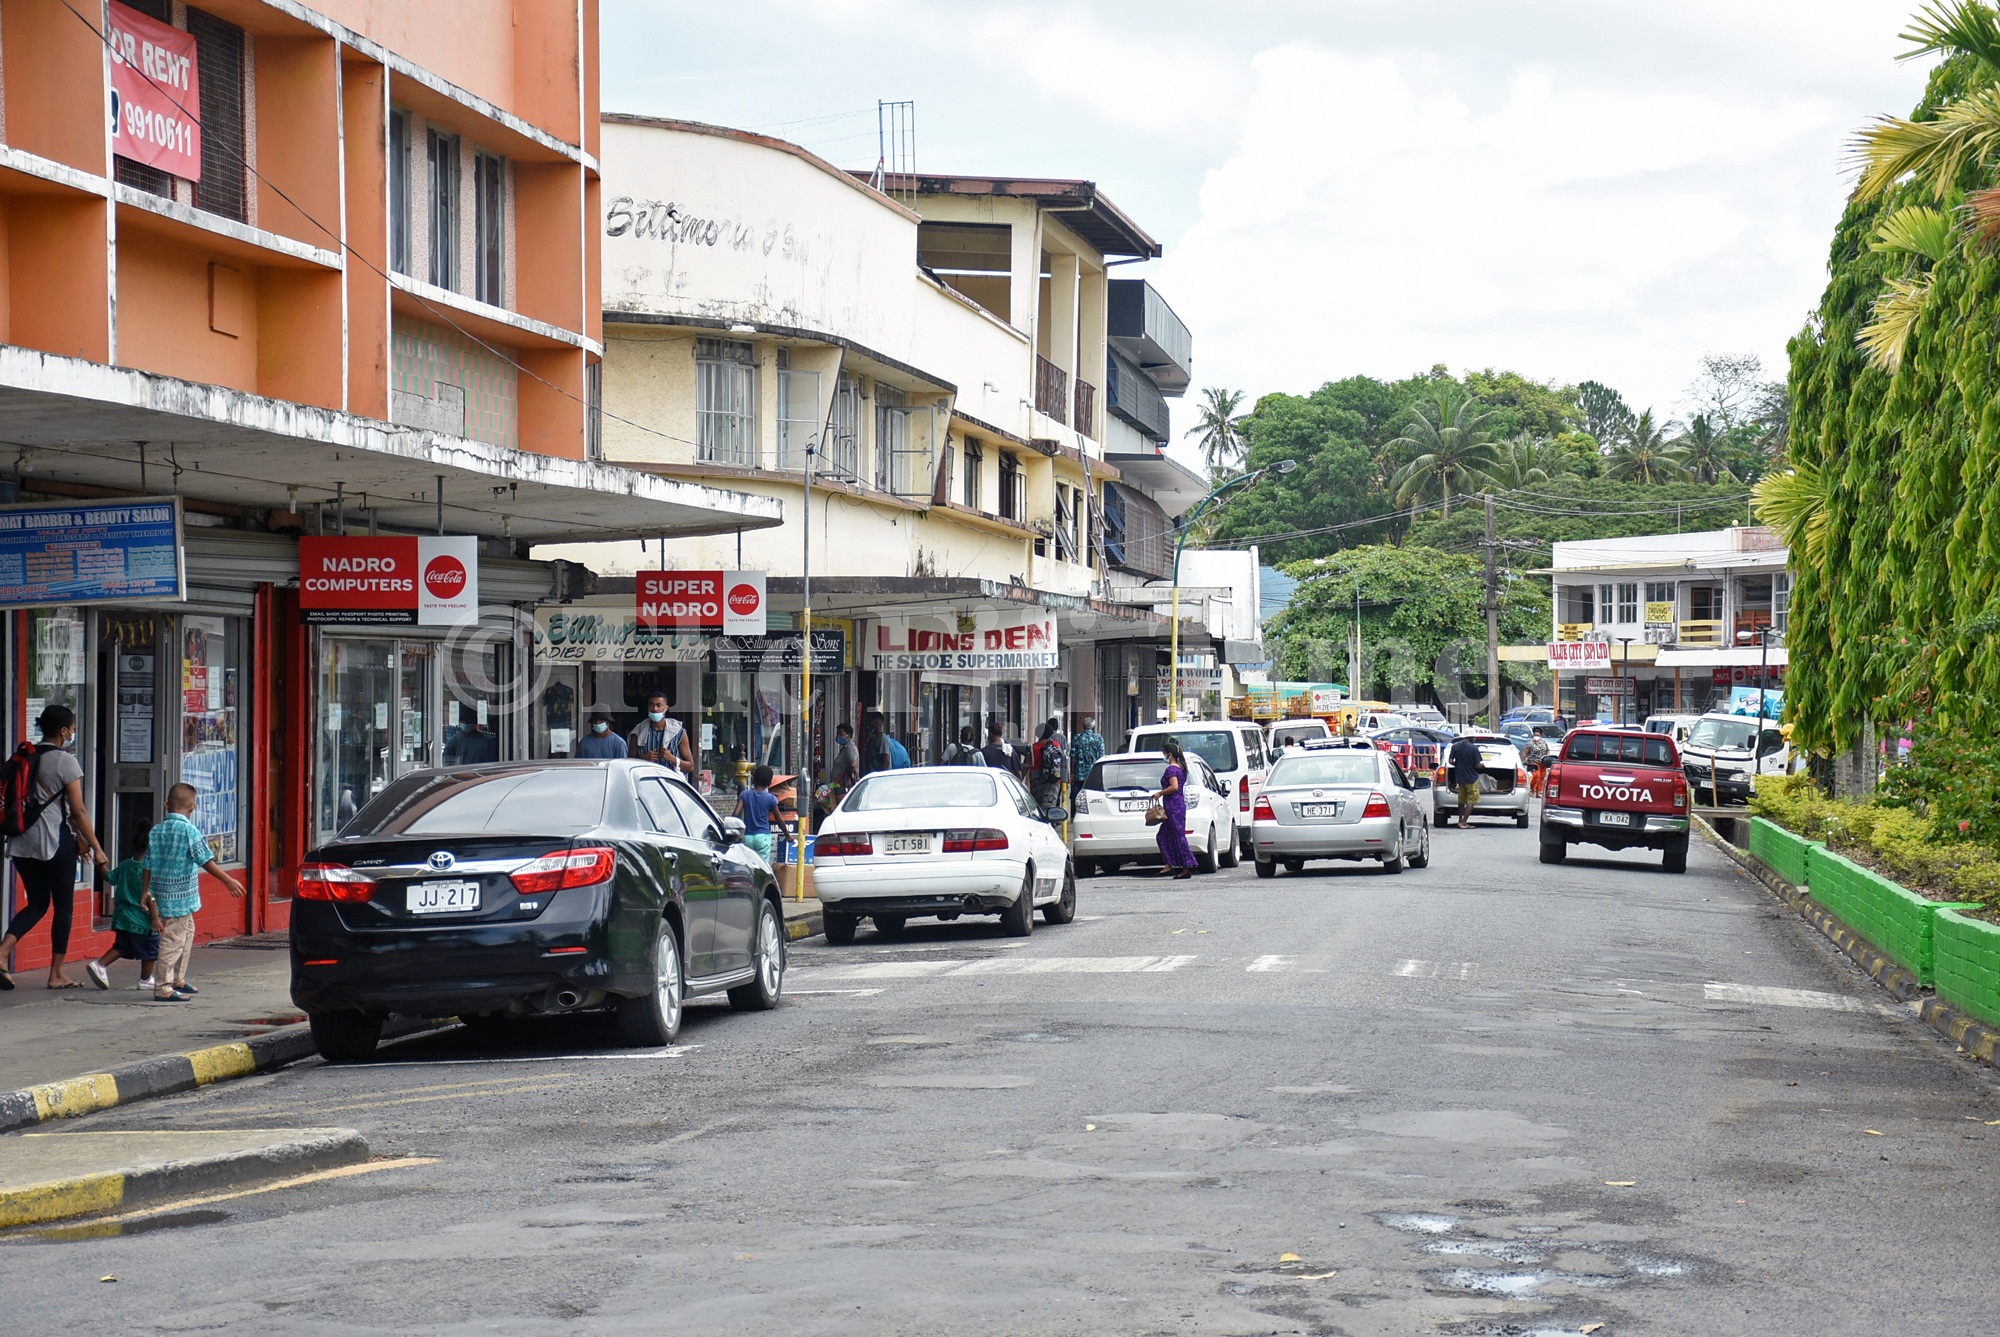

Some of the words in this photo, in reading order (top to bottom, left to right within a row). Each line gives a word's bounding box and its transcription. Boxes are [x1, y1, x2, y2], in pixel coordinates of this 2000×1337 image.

[110, 27, 138, 68] OR
[142, 41, 190, 91] RENT
[124, 101, 192, 157] 9910611
[25, 513, 72, 528] BARBER
[74, 513, 83, 526] &
[85, 510, 130, 525] BEAUTY
[131, 508, 170, 523] SALON
[99, 531, 130, 539] BEAUTY
[131, 529, 173, 537] THERAPIST
[322, 557, 396, 572] NADRO
[305, 578, 414, 592] COMPUTERS
[645, 579, 715, 595] SUPER
[642, 601, 719, 617] NADRO
[1647, 606, 1668, 615] DRIVING
[736, 633, 789, 650] Billimoria
[809, 632, 840, 650] Sons
[877, 624, 975, 652] LIONS
[984, 620, 1050, 651] DEN
[534, 645, 586, 659] ADIES
[613, 647, 665, 660] GENTS
[1548, 643, 1568, 660] VALUE
[1569, 643, 1582, 661] CITY
[1596, 642, 1608, 659] LTD
[872, 654, 893, 670] THE
[897, 653, 953, 669] SHOE
[957, 652, 1058, 669] SUPERMARKET
[1157, 668, 1183, 677] APR
[1186, 668, 1223, 678] WORLD
[1579, 784, 1653, 803] TOYOTA
[353, 858, 386, 866] CAMRY
